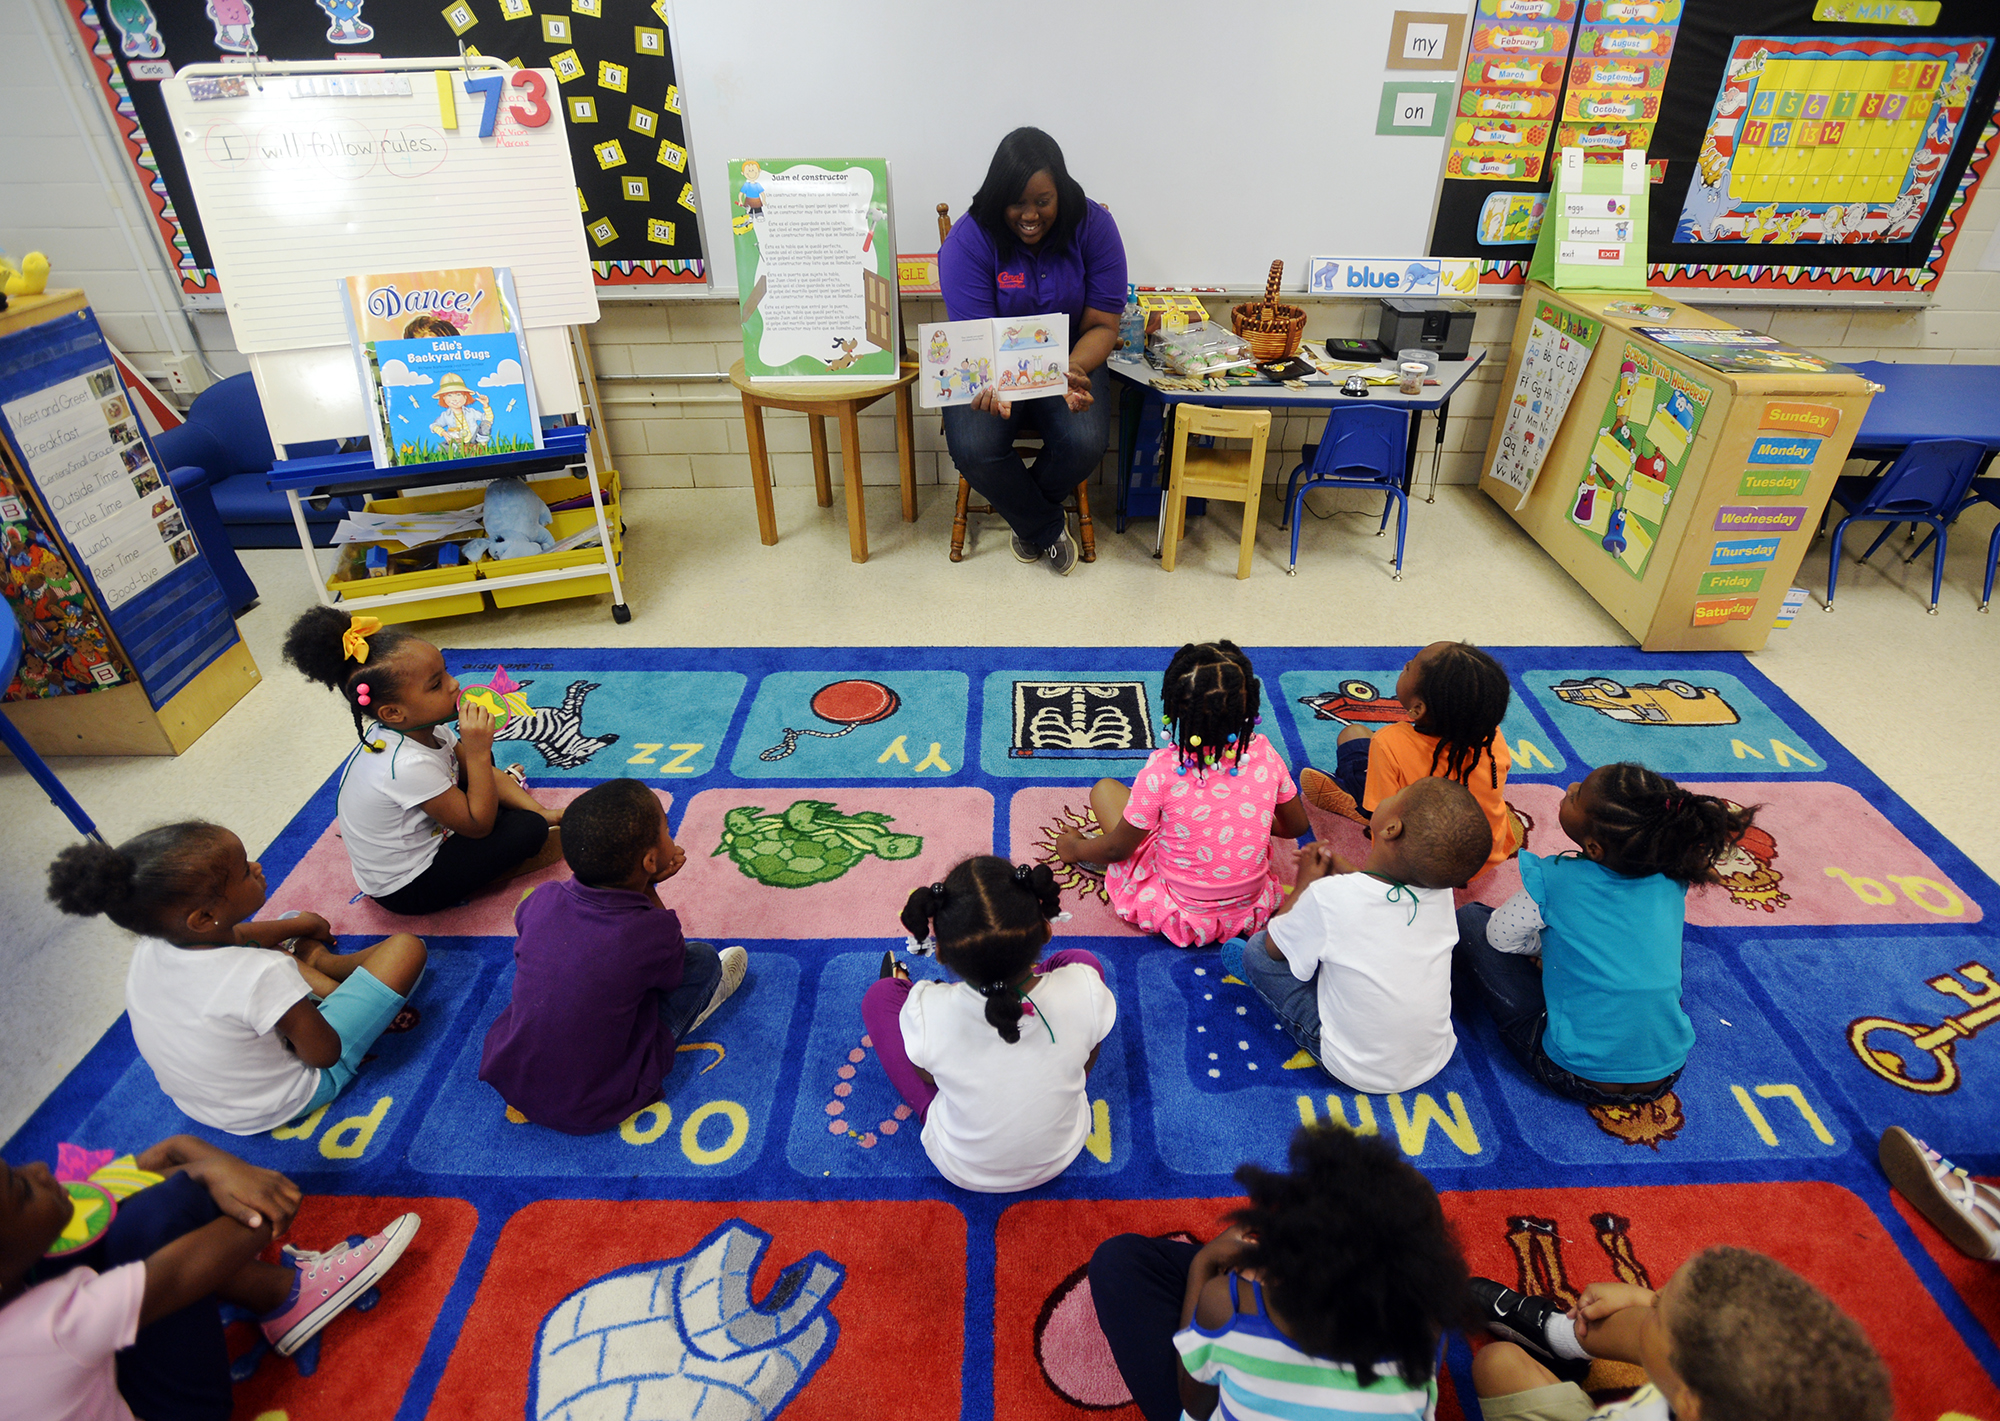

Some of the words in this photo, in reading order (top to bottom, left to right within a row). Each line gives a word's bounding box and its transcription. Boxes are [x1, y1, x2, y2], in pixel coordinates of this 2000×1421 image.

[510, 0, 519, 11] 2
[1510, 2, 1544, 12] January
[1622, 6, 1639, 16] July
[455, 10, 467, 23] 15
[1856, 6, 1897, 19] MAY
[554, 25, 560, 34] 9
[646, 36, 653, 46] 3
[1412, 36, 1438, 56] my
[1500, 38, 1539, 49] February
[1612, 39, 1641, 49] August
[140, 65, 163, 74] Circle
[562, 61, 574, 73] 26
[610, 72, 616, 82] 6
[1498, 70, 1525, 79] March
[1596, 72, 1643, 83] September
[1897, 68, 1909, 82] 2
[1922, 68, 1931, 84] 3
[580, 105, 586, 115] 1
[1404, 104, 1424, 119] on
[1496, 102, 1517, 111] April
[1592, 106, 1626, 115] October
[1758, 98, 1769, 112] 4
[1785, 98, 1798, 112] 5
[1808, 99, 1820, 114] 6
[1841, 98, 1852, 112] 7
[1866, 99, 1875, 112] 8
[1888, 98, 1900, 112] 9
[1913, 99, 1929, 113] 10
[639, 116, 648, 127] 11
[1490, 132, 1507, 142] May
[1582, 136, 1624, 145] November
[1748, 126, 1760, 140] 11
[1774, 128, 1788, 142] 12
[1804, 128, 1820, 142] 13
[1824, 126, 1841, 141] 14
[211, 135, 245, 161] I
[262, 133, 300, 158] will
[306, 132, 372, 156] follow
[381, 130, 437, 153] rules.
[496, 136, 529, 148] Marcus
[607, 150, 614, 160] 4
[668, 150, 678, 163] 18
[1480, 164, 1500, 173] June
[1569, 156, 1576, 168] E
[1630, 160, 1638, 170] e
[631, 184, 641, 194] 19
[1568, 205, 1584, 213] eggs
[598, 226, 609, 238] 25
[656, 227, 667, 238] 24
[1571, 227, 1600, 237] elephant
[1562, 250, 1575, 258] exit
[1347, 265, 1400, 289] blue
[368, 285, 484, 320] Dance!
[1552, 312, 1593, 341] Alphabet
[432, 340, 463, 351] Edie's
[407, 350, 462, 364] Backyard
[463, 348, 491, 361] Bugs
[1543, 350, 1552, 362] Bb
[1556, 356, 1565, 369] Cc
[1568, 361, 1578, 376] Dd
[1520, 376, 1529, 388] Ff
[1532, 381, 1542, 398] Gg
[10, 408, 39, 430] Meet
[41, 401, 59, 418] and
[58, 390, 89, 414] Greet
[1526, 414, 1538, 429] Mm
[1769, 409, 1830, 428] Sunday
[24, 427, 80, 459] Breakfast
[1503, 436, 1516, 457] Qq
[90, 445, 114, 463] Groups
[1758, 444, 1811, 459] Monday
[1496, 464, 1506, 477] Vv
[1510, 470, 1522, 487] Ww
[52, 482, 94, 511] Outside
[98, 468, 119, 486] Time
[1746, 476, 1801, 490] Tuesday
[2, 504, 20, 518] B
[64, 511, 98, 536] Circle
[98, 498, 123, 518] Time
[1722, 513, 1797, 527] Wednesday
[80, 534, 113, 559] Lunch
[1716, 545, 1776, 558] Thursday
[93, 562, 115, 582] Rest
[116, 548, 140, 568] Time
[108, 566, 159, 604] Good-bye
[1710, 576, 1753, 589] Friday
[1696, 602, 1753, 618] Saturday
[98, 668, 114, 681] B
